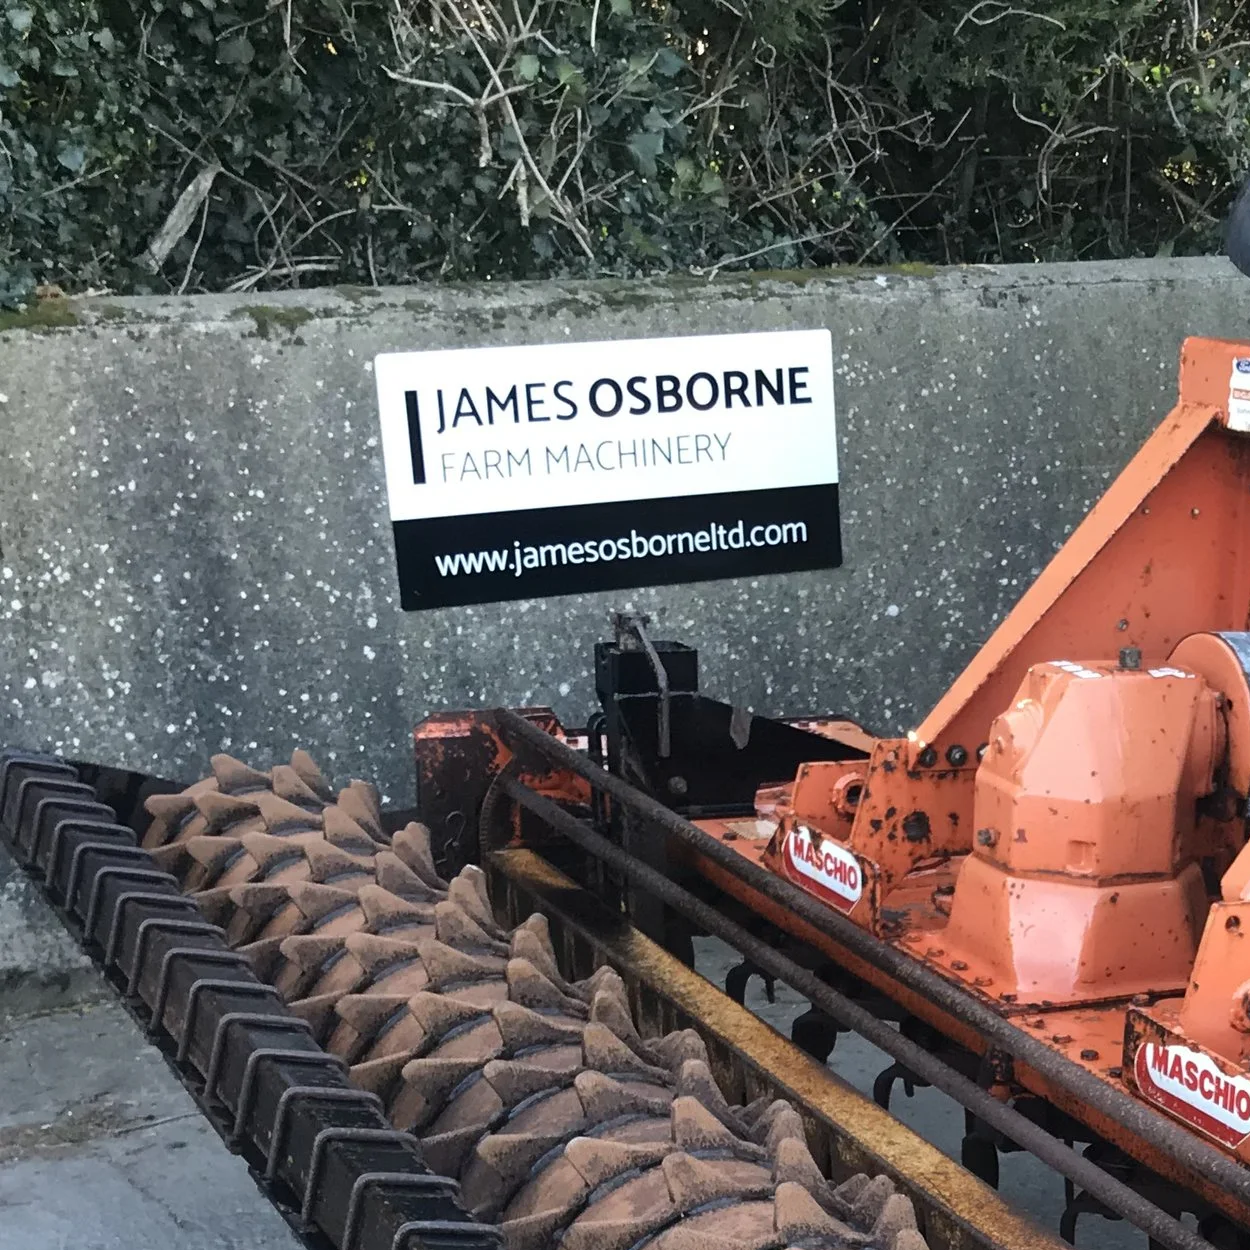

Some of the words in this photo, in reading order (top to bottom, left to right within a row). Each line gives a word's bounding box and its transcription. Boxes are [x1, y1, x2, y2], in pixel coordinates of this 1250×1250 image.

[436, 380, 578, 434] JAMES
[588, 366, 812, 417] OSBORNE
[441, 447, 532, 482] FARM
[545, 432, 732, 475] MACHINERY
[435, 520, 807, 578] www.jamesosborneltd.com
[793, 834, 858, 890] MASCHIO
